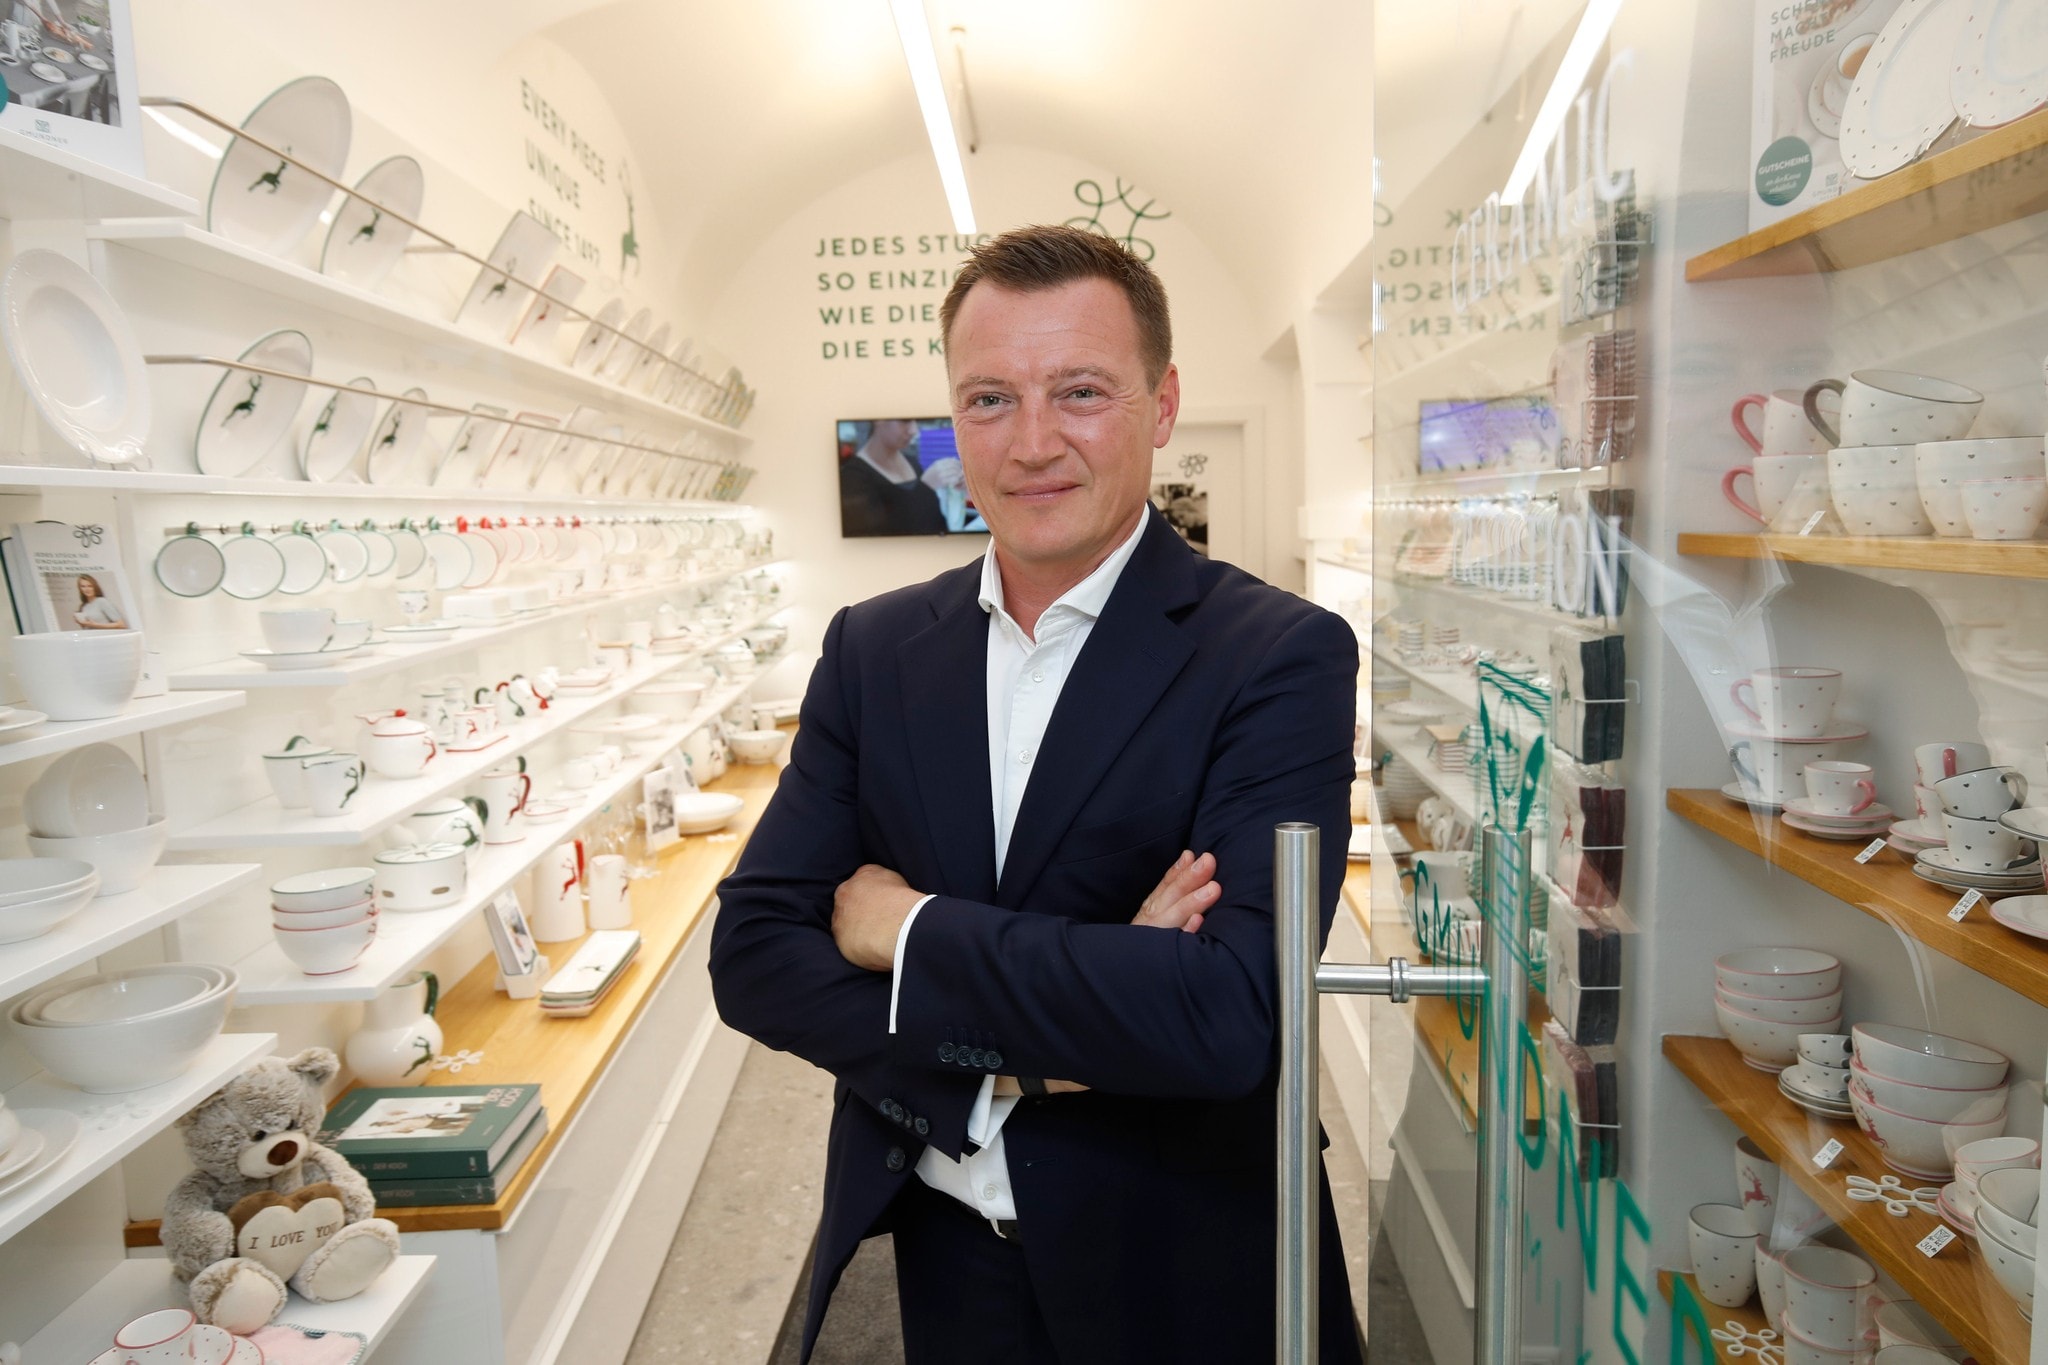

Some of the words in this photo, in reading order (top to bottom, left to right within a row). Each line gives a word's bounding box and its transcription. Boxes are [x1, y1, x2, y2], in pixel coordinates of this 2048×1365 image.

[1770, 12, 1828, 43] MACHT
[1770, 29, 1835, 63] FREUDE
[521, 76, 565, 147] EVERY
[571, 128, 606, 185] PIECE
[524, 135, 581, 211] UNIQUE
[1757, 153, 1810, 176] GUTSCHEINE
[815, 236, 905, 258] JEDES
[818, 271, 855, 292] SO
[819, 305, 875, 325] WIE
[888, 303, 935, 323] DIE
[822, 341, 869, 360] DIE
[883, 338, 914, 357] ES
[928, 338, 944, 355] K
[247, 1237, 259, 1249] I
[270, 1230, 305, 1249] LOVE
